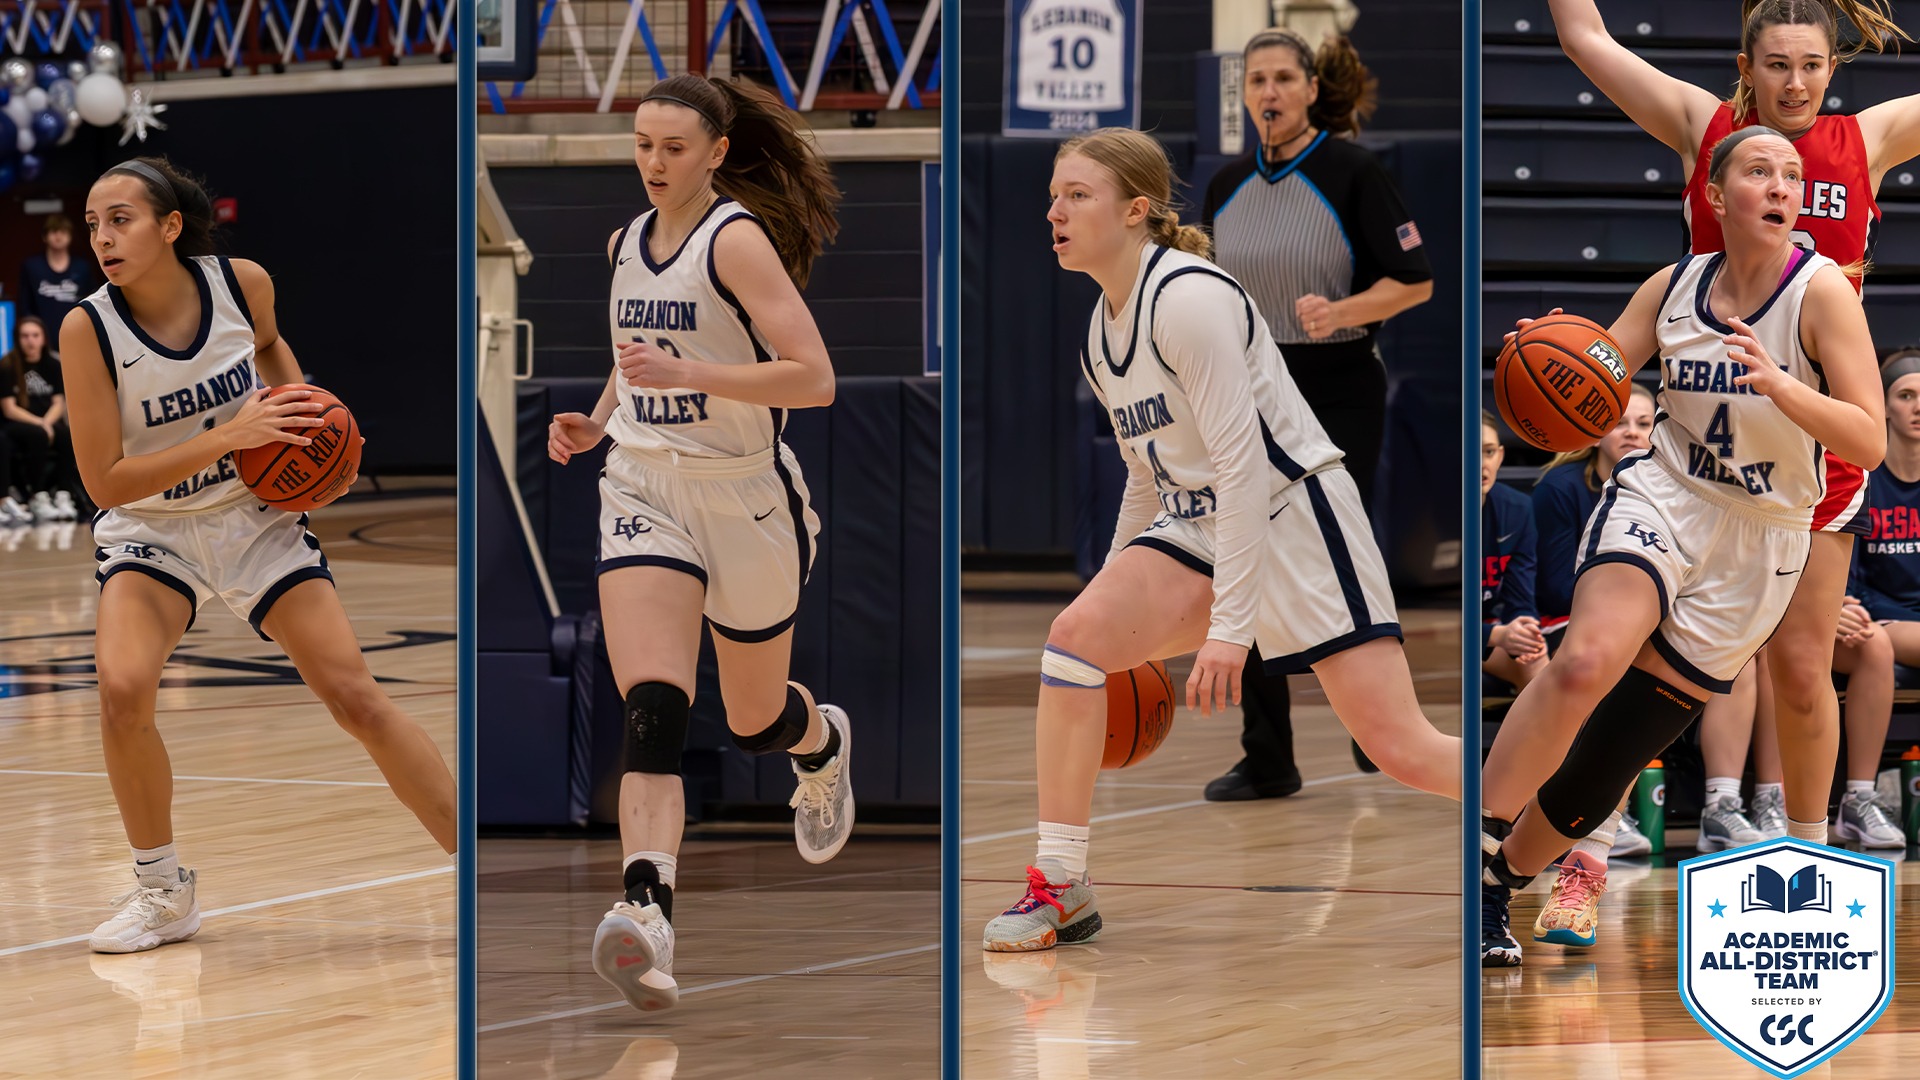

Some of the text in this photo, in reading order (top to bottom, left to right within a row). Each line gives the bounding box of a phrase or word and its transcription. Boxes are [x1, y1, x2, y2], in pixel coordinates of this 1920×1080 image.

[1049, 35, 1095, 70] 10
[617, 298, 697, 332] LEBANON
[1589, 344, 1624, 381] MAC
[1665, 358, 1790, 396] LEBAN
[141, 359, 253, 428] LEBANON
[1541, 357, 1615, 432] THE ROCK
[1704, 402, 1734, 459] 4
[271, 458, 312, 495] THE
[300, 421, 344, 468] ROCK
[1688, 442, 1775, 496] VALEY
[612, 514, 653, 542] LVC
[1624, 521, 1669, 553] LVC
